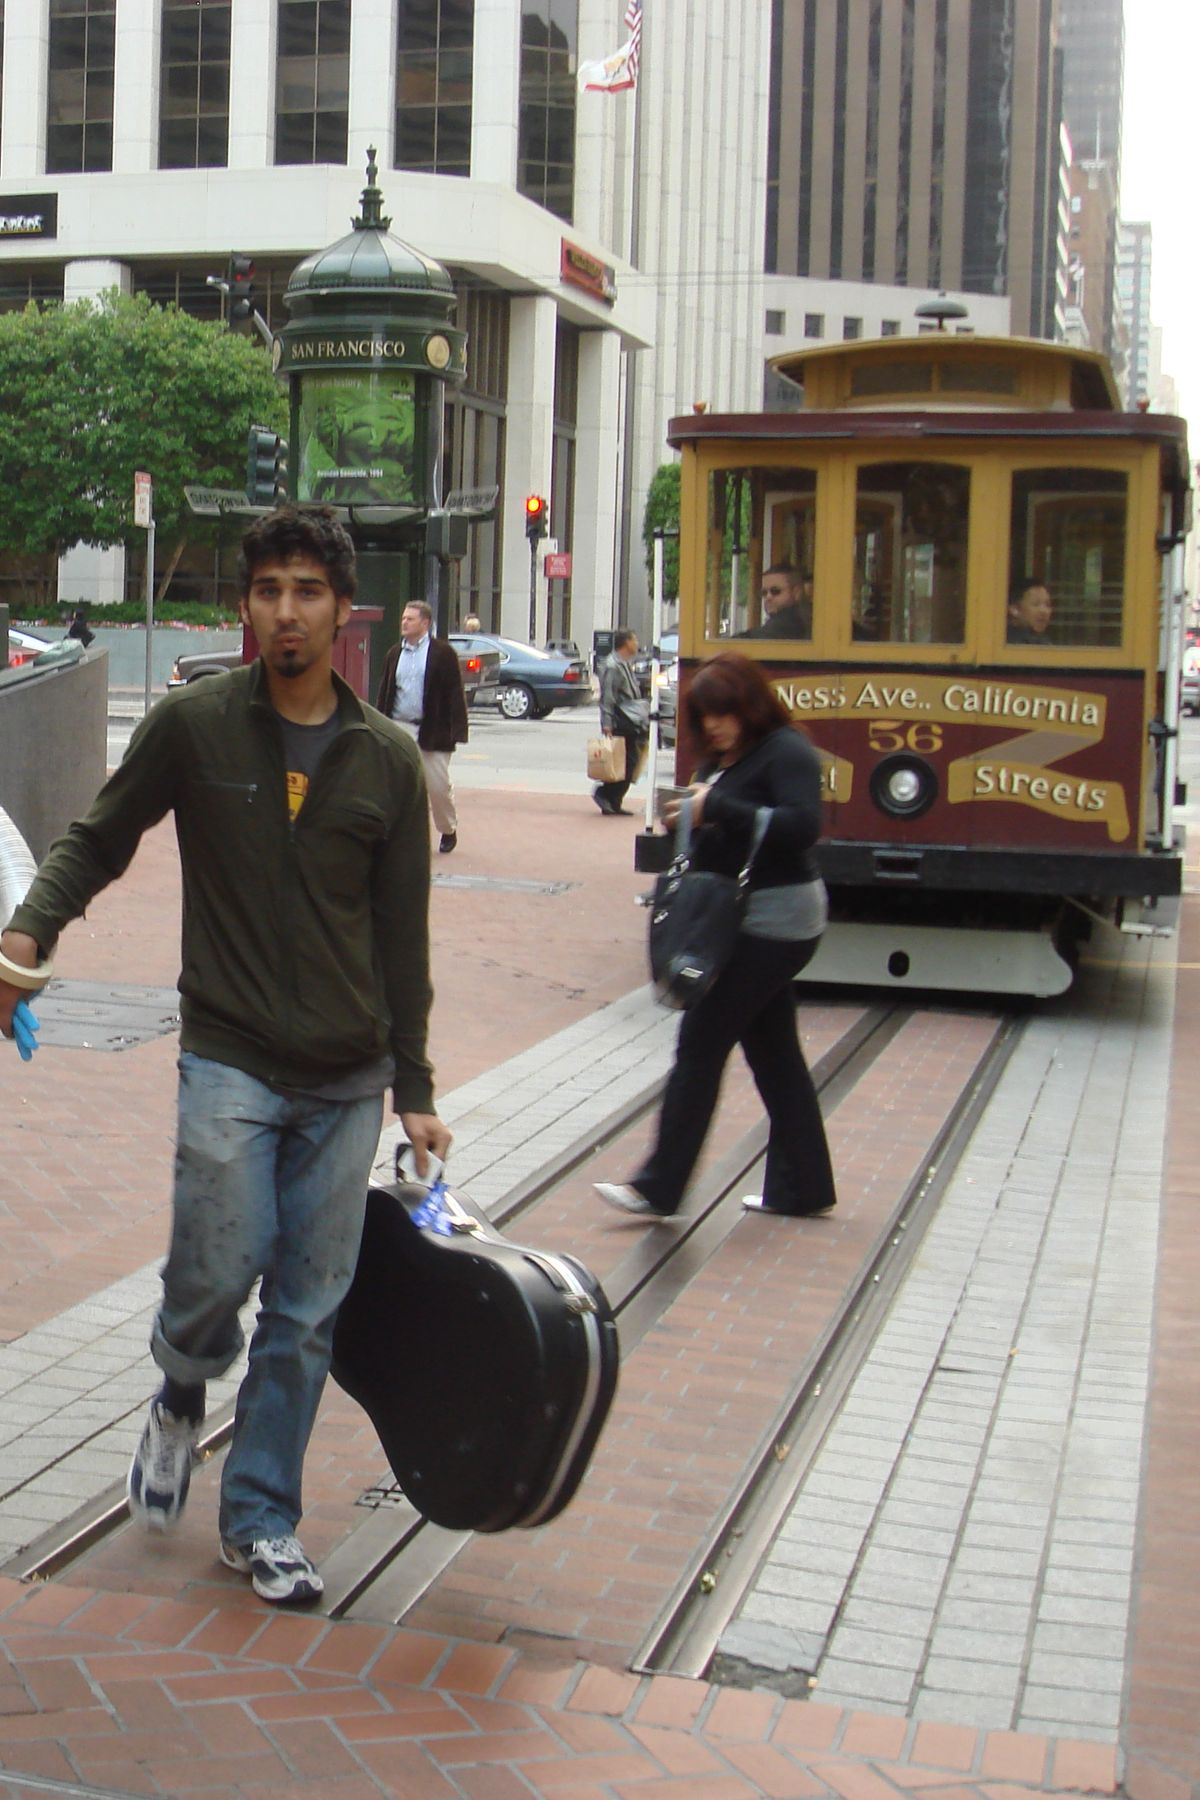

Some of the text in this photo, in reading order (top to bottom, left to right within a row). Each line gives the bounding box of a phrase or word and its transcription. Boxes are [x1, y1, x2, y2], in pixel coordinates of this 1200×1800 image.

[291, 339, 406, 359] SAN FRANCISCO
[776, 684, 847, 711] Ness
[943, 684, 1099, 727] California
[868, 720, 944, 754] 56
[973, 765, 1107, 811] Streets
